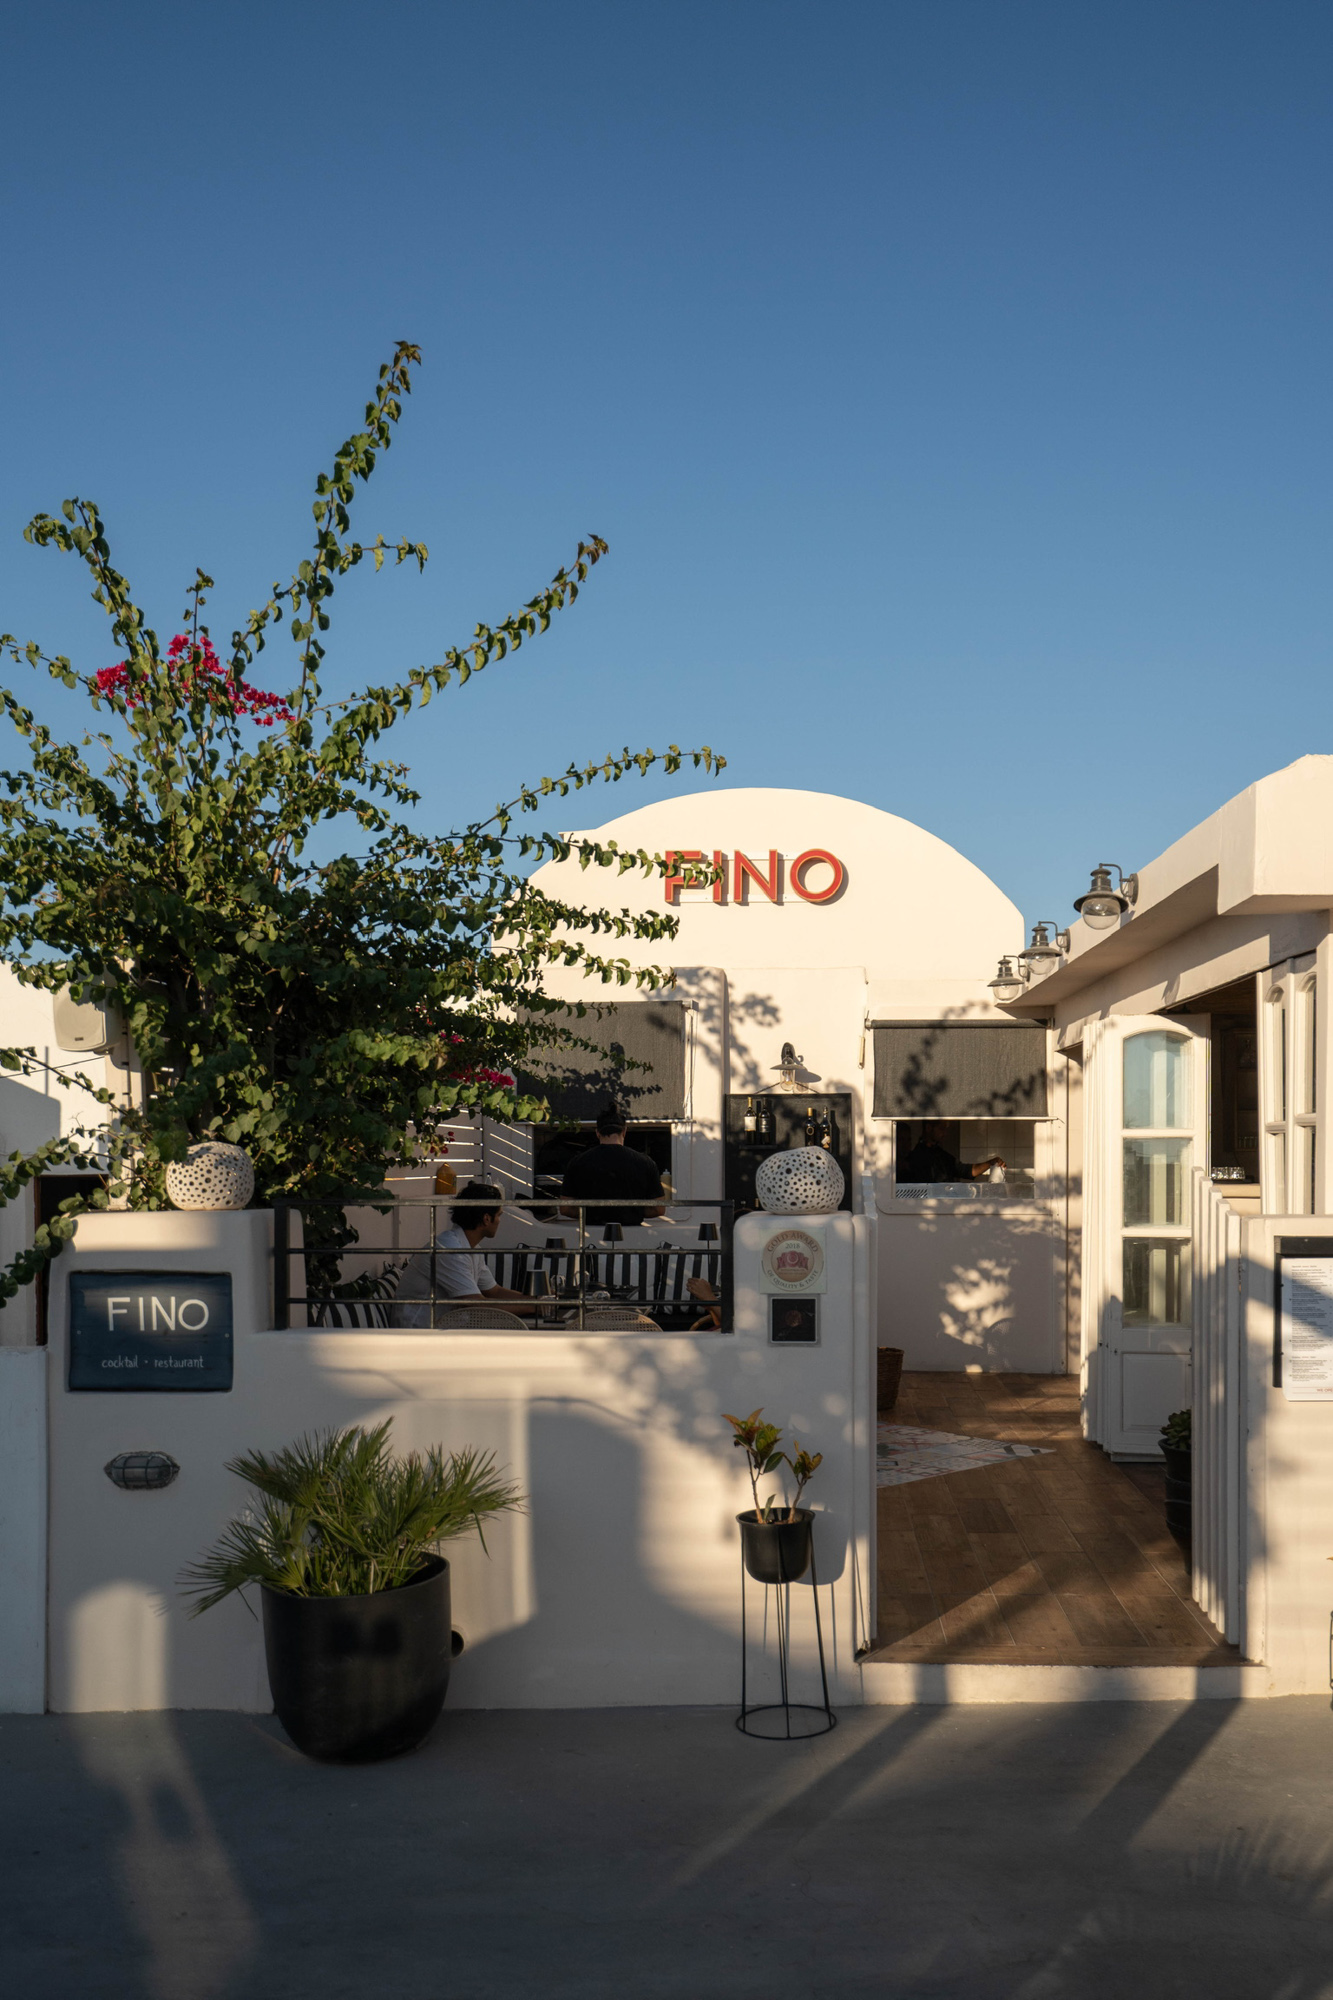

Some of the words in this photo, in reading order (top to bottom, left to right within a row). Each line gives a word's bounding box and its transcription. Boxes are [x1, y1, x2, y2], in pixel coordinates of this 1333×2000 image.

[665, 848, 843, 903] FINO
[767, 1233, 789, 1252] GOLD
[790, 1232, 818, 1252] AWARD
[767, 1269, 775, 1278] OF
[773, 1277, 799, 1289] QUALITY
[804, 1270, 819, 1285] TASTE
[107, 1296, 209, 1331] FINO
[102, 1355, 138, 1368] cocktail
[154, 1356, 204, 1368] restaurant
